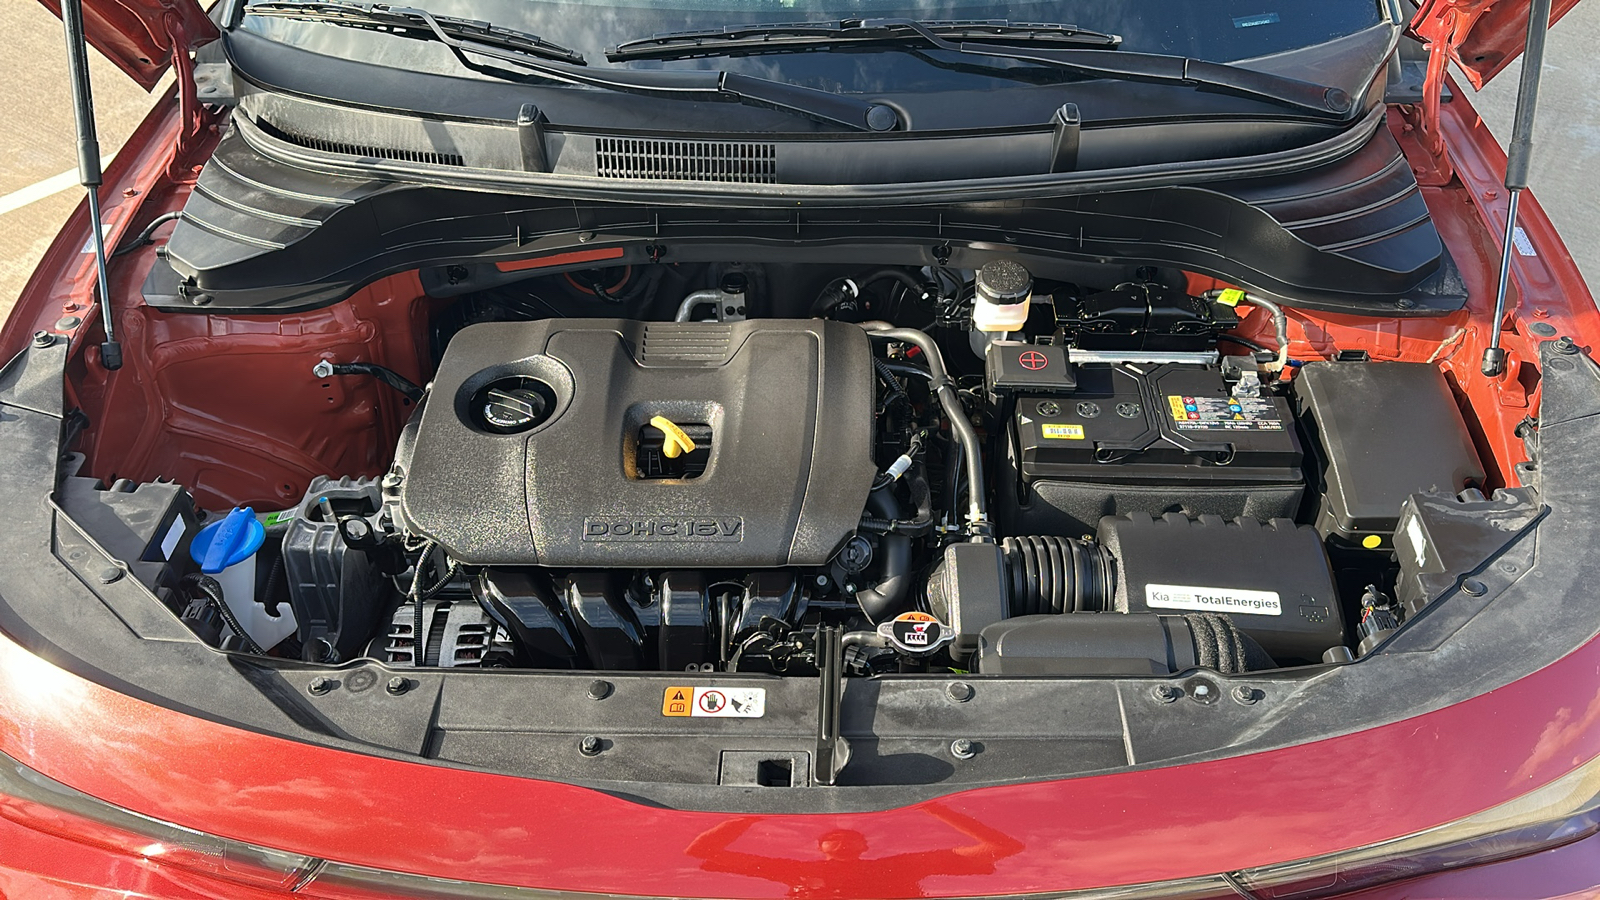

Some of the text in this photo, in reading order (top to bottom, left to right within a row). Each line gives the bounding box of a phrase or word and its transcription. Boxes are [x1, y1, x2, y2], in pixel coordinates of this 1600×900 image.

[586, 521, 742, 537] DOHC 16V
[1152, 591, 1170, 602] Kia
[1194, 594, 1279, 609] TotalEnergies
